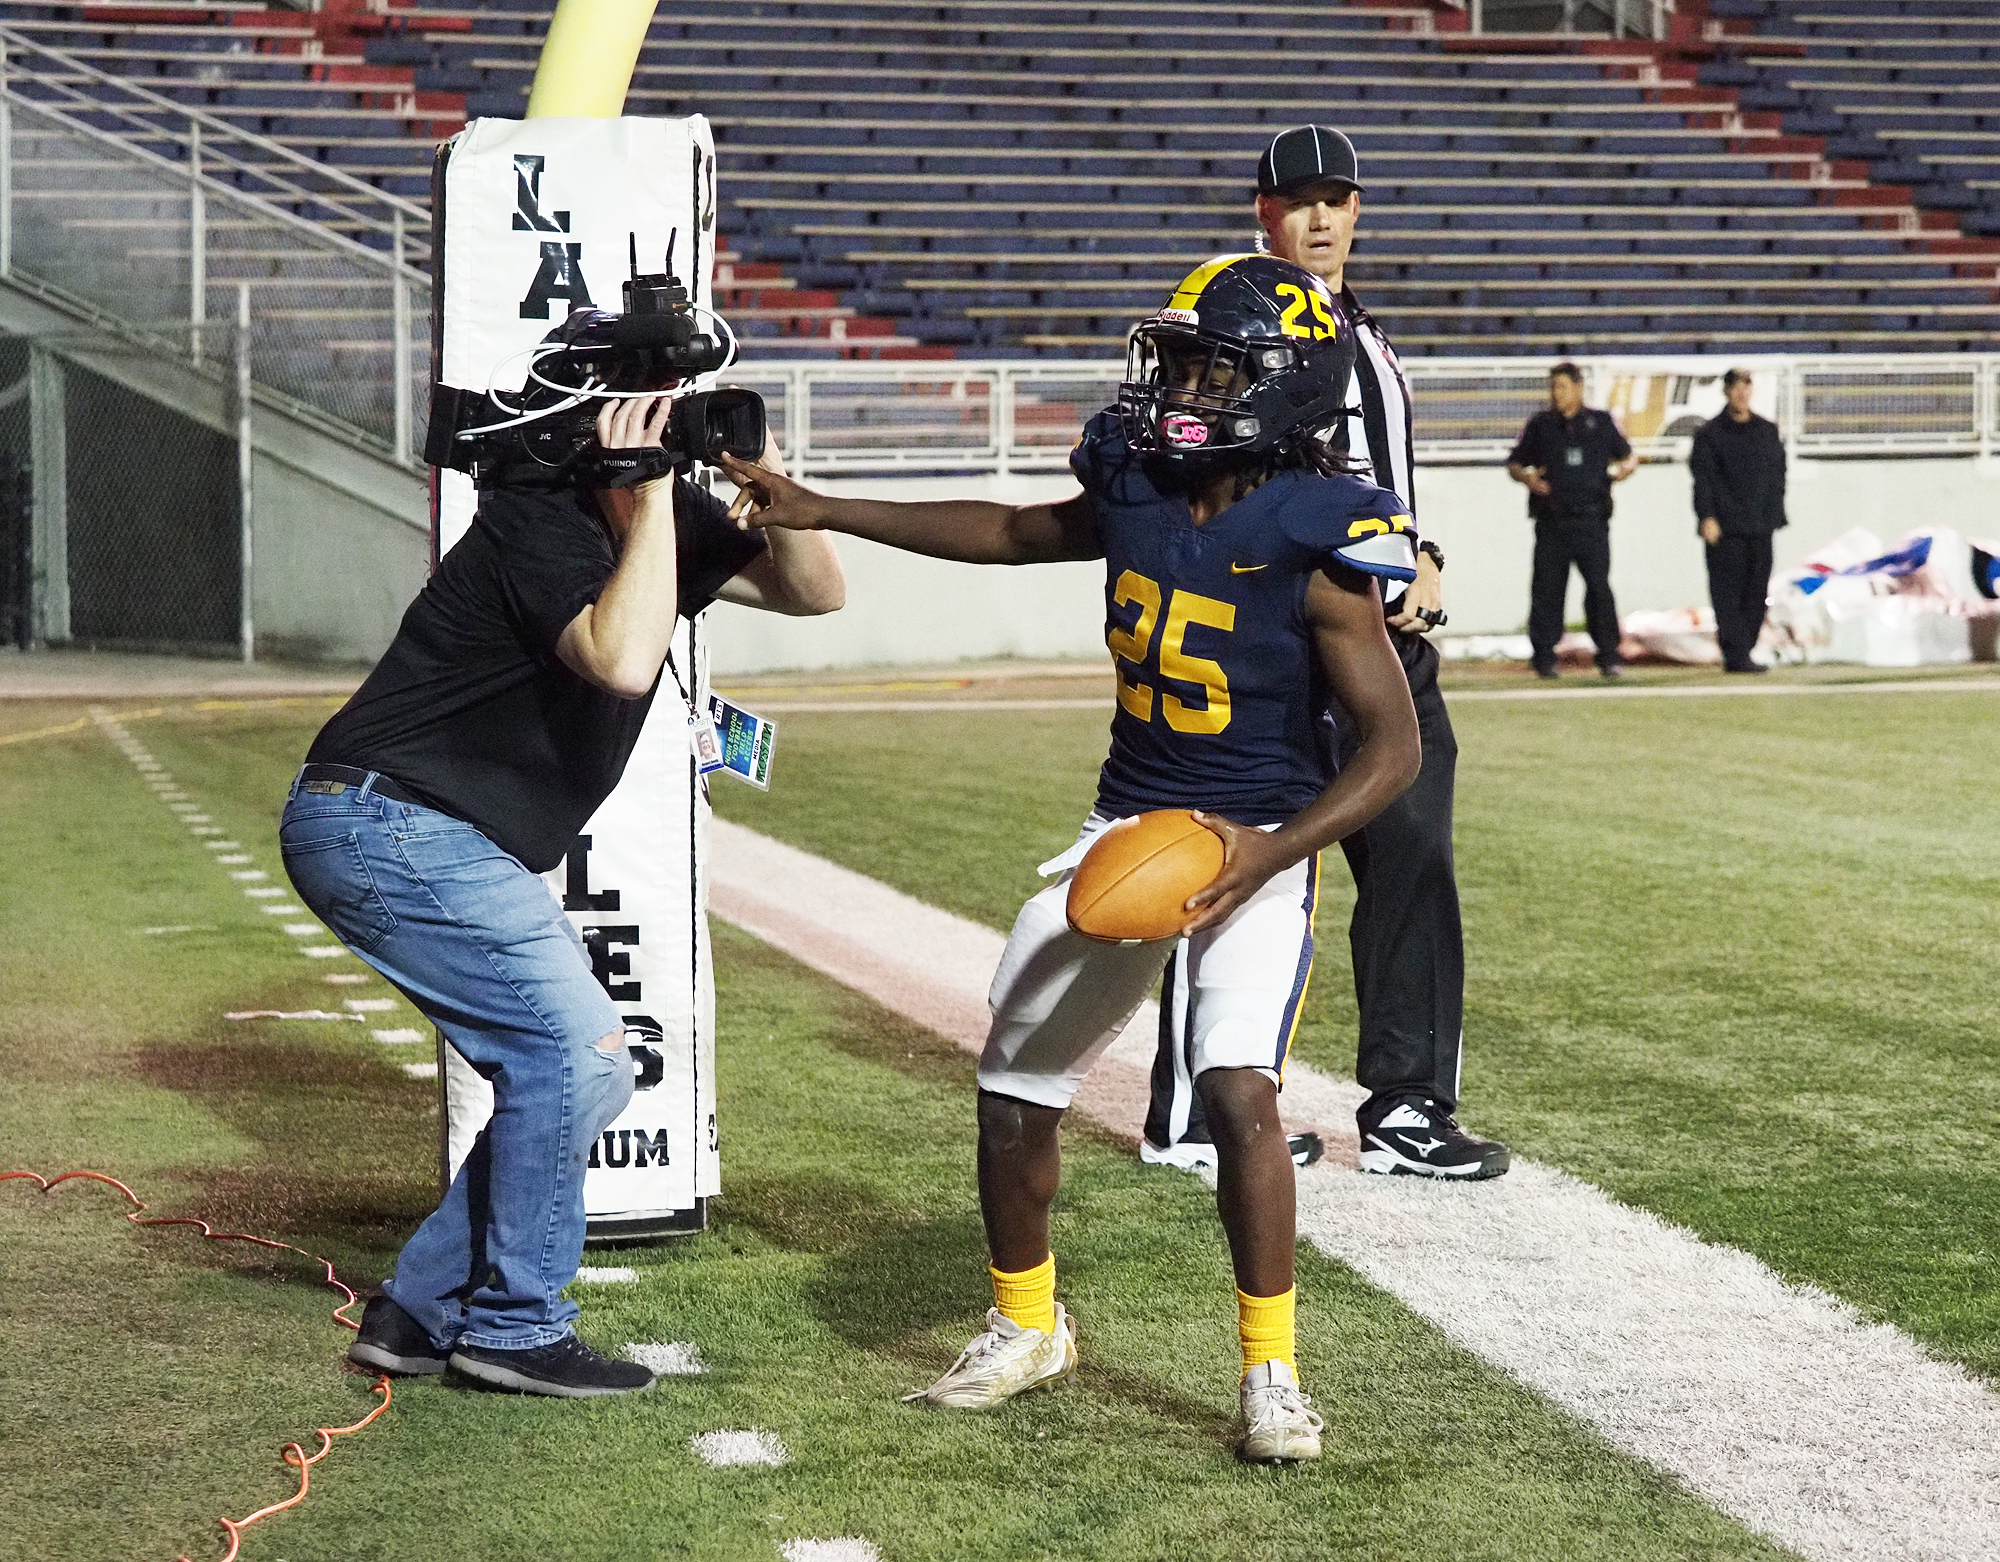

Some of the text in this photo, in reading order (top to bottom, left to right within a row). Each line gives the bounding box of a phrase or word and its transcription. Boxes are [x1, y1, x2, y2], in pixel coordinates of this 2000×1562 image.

[1274, 282, 1337, 343] 25
[1108, 569, 1236, 735] 25
[728, 712, 738, 742] SCHOOL
[731, 721, 743, 761] FOOTBALL
[739, 731, 747, 755] FIELD
[743, 729, 754, 762] ACCESS
[587, 1128, 670, 1169] IUM
